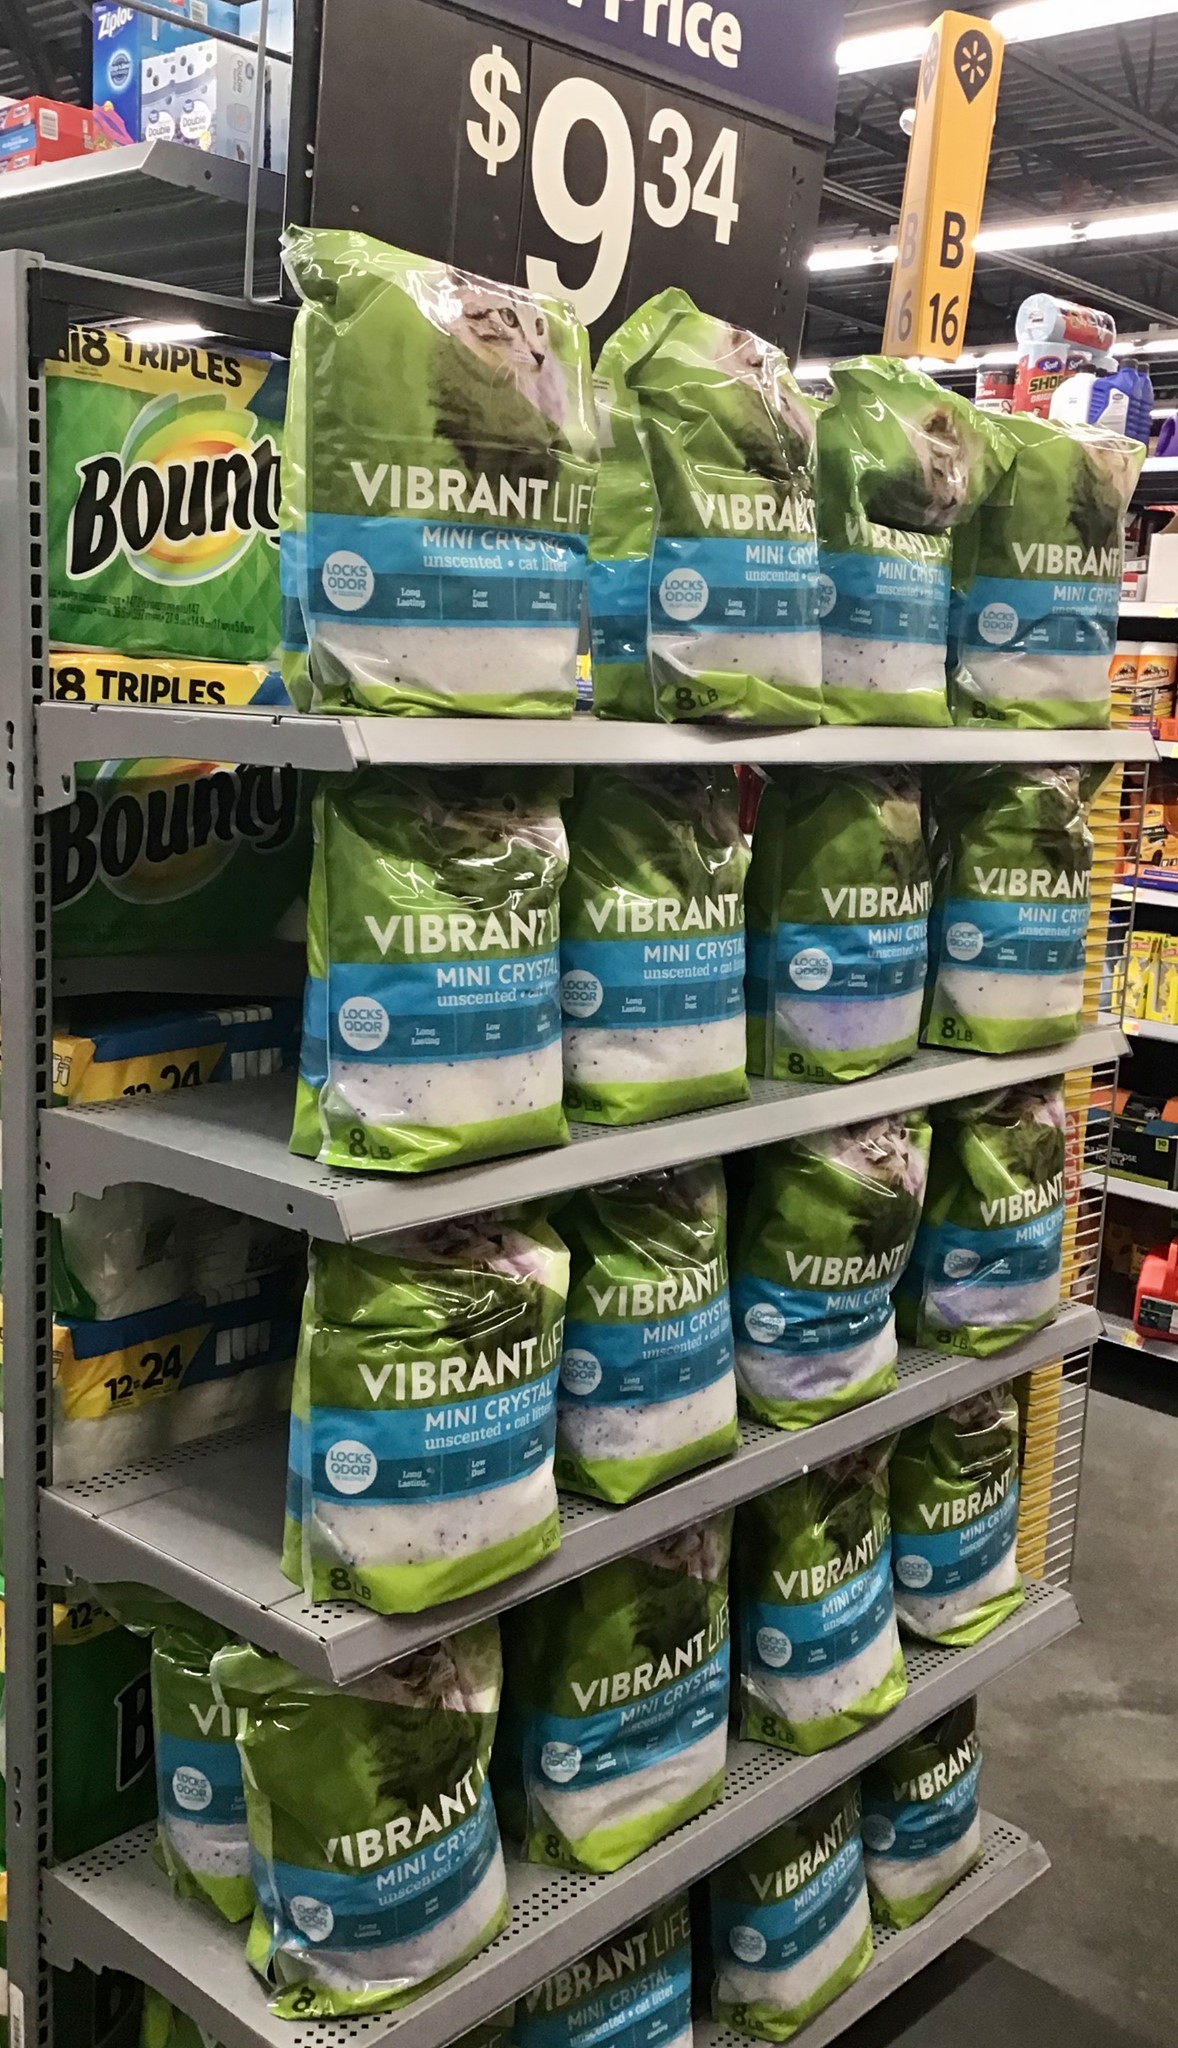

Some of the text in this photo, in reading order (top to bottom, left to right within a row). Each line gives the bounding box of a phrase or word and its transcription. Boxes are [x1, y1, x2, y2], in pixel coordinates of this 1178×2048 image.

[148, 126, 171, 137] Double
[183, 115, 206, 127] Double
[644, 107, 739, 245] 34
[899, 212, 918, 268] B
[940, 211, 965, 269] B
[930, 293, 960, 347] 16
[114, 331, 242, 387] TRIPLES
[350, 462, 549, 520] VIBRANT
[422, 525, 473, 549] MINI
[423, 554, 503, 570] unscented
[519, 558, 539, 571] cat
[745, 544, 783, 565] MINI
[1012, 542, 1117, 577] VIBRANT
[326, 563, 368, 578] LOCKS
[745, 570, 799, 582] unscented
[877, 561, 907, 580] MINI
[328, 577, 367, 591] ODOR
[401, 587, 488, 599] Long Low
[664, 579, 704, 591] LOCKS
[1053, 585, 1084, 601] MINI
[397, 597, 426, 608] Lasting
[664, 591, 703, 604] ODOR
[983, 611, 1015, 621] LOCKS
[983, 621, 1014, 630] ODOR
[95, 669, 226, 705] TRIPLES
[674, 687, 719, 711] 8 LB
[972, 701, 988, 719] 8
[52, 763, 296, 906] Bounty
[974, 866, 1091, 899] VIBRANT
[821, 881, 931, 919] VIBRANT
[584, 893, 738, 933] VIBRANT
[1018, 907, 1057, 923] MINI
[364, 909, 550, 956] VIBRANT
[868, 928, 902, 945] MINI
[643, 943, 690, 963] MINI
[795, 957, 829, 967] LOCKS
[436, 957, 559, 989] MINI CRYSTAL
[643, 963, 711, 980] unscented
[562, 980, 598, 991] LOCKS
[563, 991, 597, 1001] ODOR
[437, 988, 517, 1007] unscented
[625, 997, 643, 1006] Long
[343, 1009, 384, 1022] LOCKS
[621, 1005, 646, 1014] Lasting
[344, 1021, 383, 1033] ODOR
[415, 1023, 500, 1038] Long Low
[941, 1017, 974, 1042] 8 LB
[411, 1036, 440, 1047] Lasting
[788, 1053, 825, 1077] 8 LB
[348, 1129, 392, 1160] 8 LB
[980, 1171, 1064, 1226] VIBRANT
[1015, 1223, 1044, 1243] MINI
[786, 1243, 905, 1286] VIBRANT
[587, 1257, 719, 1317] VIBRANT
[826, 1294, 861, 1311] MINI
[643, 1320, 685, 1344] MINI
[953, 1335, 970, 1350] LB
[357, 1315, 566, 1402] VIBRANT LIF
[562, 1358, 597, 1370] LOCKS
[563, 1369, 597, 1380] ODOR
[424, 1379, 553, 1432] MINI CRYSTAL
[424, 1422, 502, 1450] unscented
[514, 1413, 530, 1430] cat
[330, 1450, 372, 1464] LOCKS
[331, 1463, 371, 1476] ODOR
[402, 1470, 423, 1480] Long
[918, 1468, 1011, 1529] VIBRANT
[960, 1522, 985, 1544] MINI
[773, 1530, 874, 1599] VIBRANT
[329, 1567, 372, 1600] 8 LB
[822, 1590, 850, 1618] MINI
[571, 1629, 706, 1712] VIBRANT
[620, 1698, 659, 1727] MINI
[663, 1659, 723, 1706] CRYSTAL
[761, 1716, 794, 1744] 8 LB
[323, 1766, 478, 1868] VIBRANT
[544, 1834, 560, 1860] 8
[750, 1812, 843, 1901] VIBRANT
[376, 1854, 427, 1891] MINI
[378, 1860, 452, 1906] unscented
[525, 1932, 648, 2014] VIBRANT
[652, 1905, 692, 1957] LIFE
[567, 2001, 606, 2031] MINI
[609, 1966, 672, 2011] CRYSTAL
[731, 2004, 748, 2027] 8
